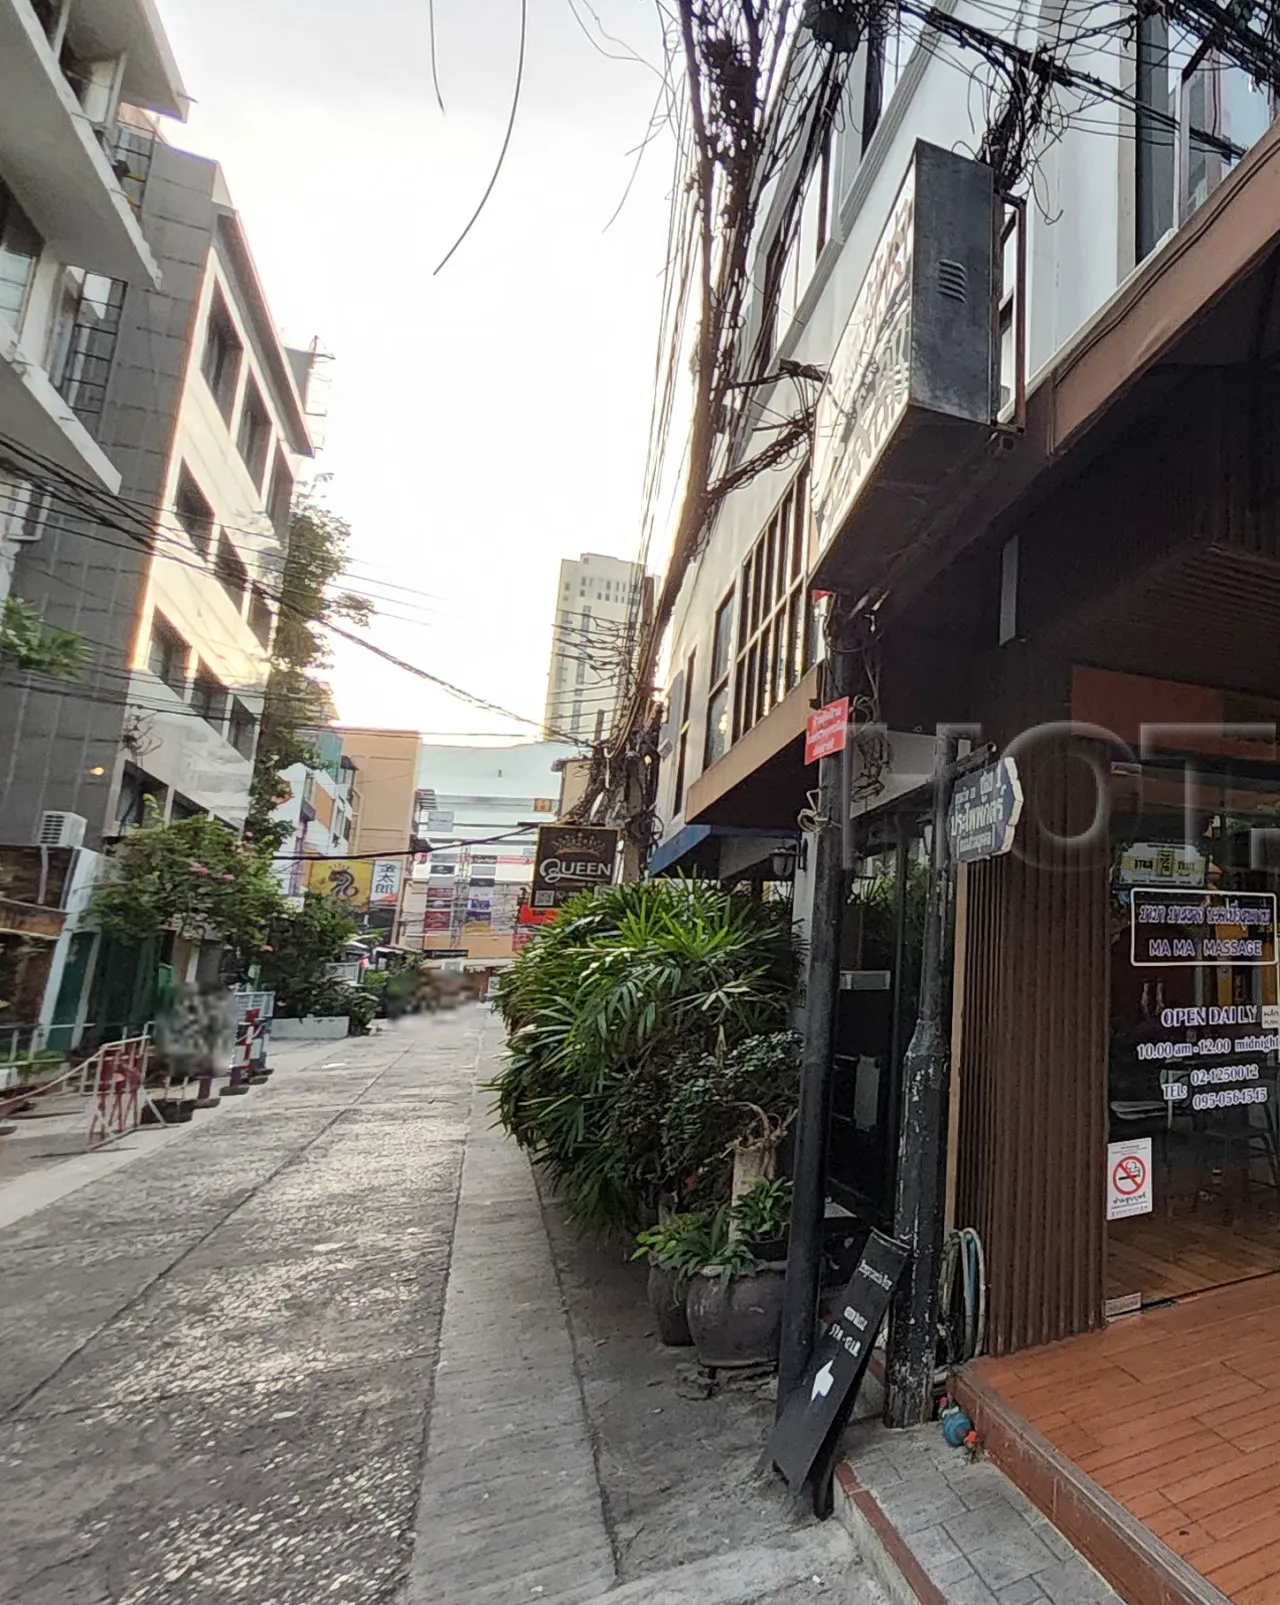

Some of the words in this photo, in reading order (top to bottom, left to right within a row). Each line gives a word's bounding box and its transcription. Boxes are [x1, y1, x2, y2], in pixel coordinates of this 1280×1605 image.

[539, 858, 612, 884] QUEEN
[1149, 939, 1171, 956] MA
[1173, 939, 1195, 956] MA
[1203, 939, 1263, 956] MASSAGE
[1161, 1007, 1206, 1027] OPEN
[1208, 1005, 1258, 1025] DAILY
[1234, 1035, 1280, 1052] midnight
[1190, 1064, 1259, 1086] 02-1250012
[1161, 1083, 1188, 1099] TEL:
